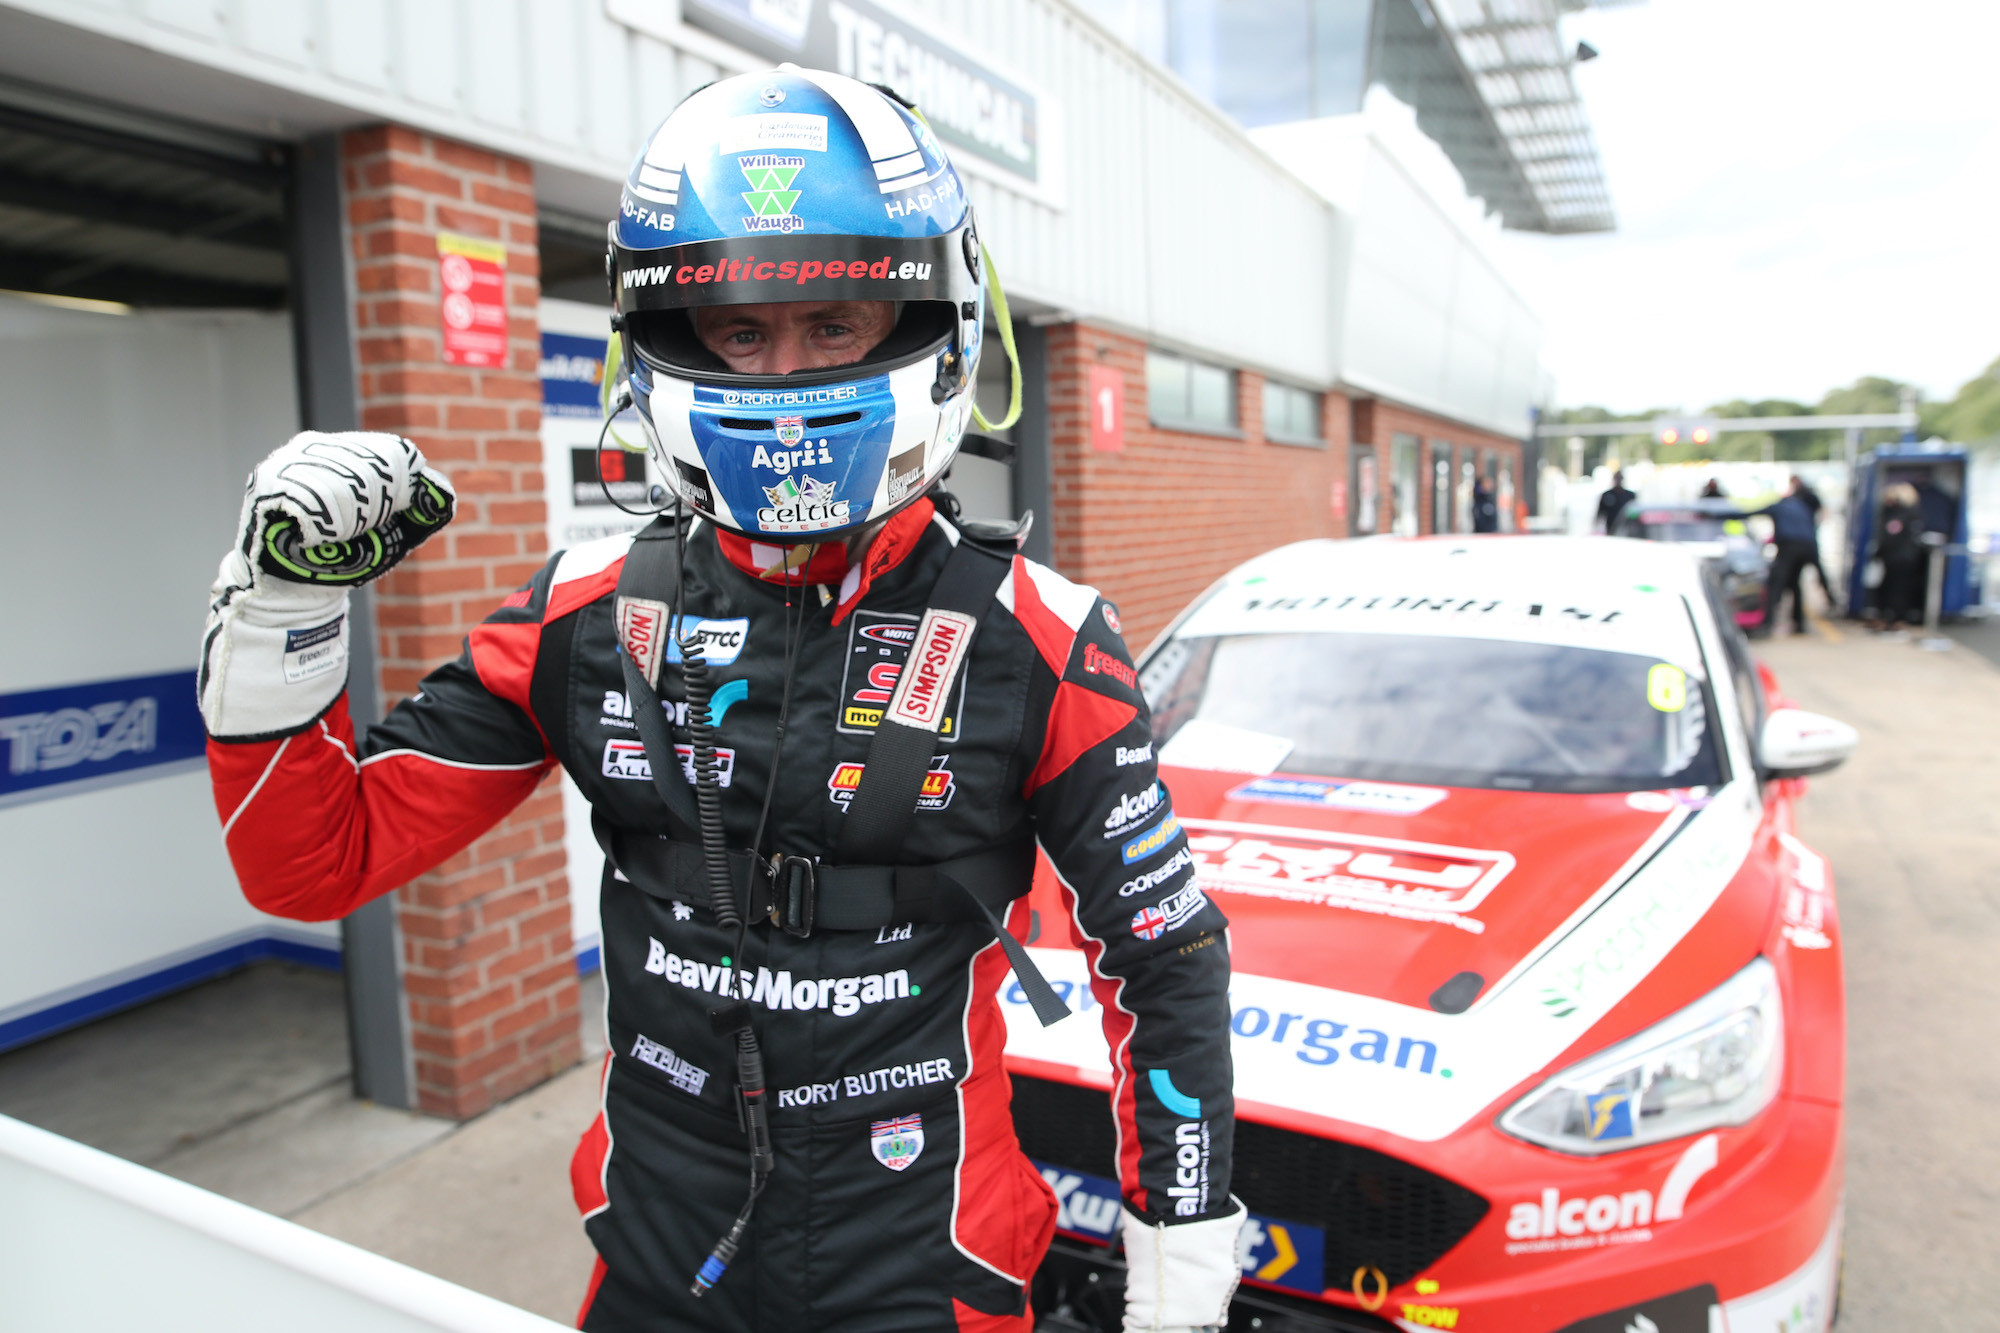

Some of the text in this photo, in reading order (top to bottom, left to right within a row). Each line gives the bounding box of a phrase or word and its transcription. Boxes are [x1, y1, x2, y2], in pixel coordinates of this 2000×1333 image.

[829, 2, 1031, 163] TECHNICAL
[740, 155, 803, 168] William
[621, 197, 675, 231] AD-FAB
[884, 174, 957, 219] HAD-FAB
[744, 215, 802, 231] Waugh
[622, 256, 932, 289] www celticspeed.eu
[723, 386, 857, 406] @RORYBUTCHER
[1098, 387, 1114, 433] 1
[751, 438, 833, 475] Agrii
[761, 518, 848, 530] SPEED
[907, 624, 957, 715] SIMPSON
[1084, 642, 1138, 690] freem
[1104, 782, 1159, 829] alcon
[1119, 846, 1192, 897] CORBEAU
[874, 922, 912, 944] Ltd
[778, 1057, 955, 1108] RORY BUTCHER
[1167, 1123, 1201, 1216] alcon
[1505, 1188, 1653, 1240] alcon
[1400, 1303, 1458, 1329] TOW
